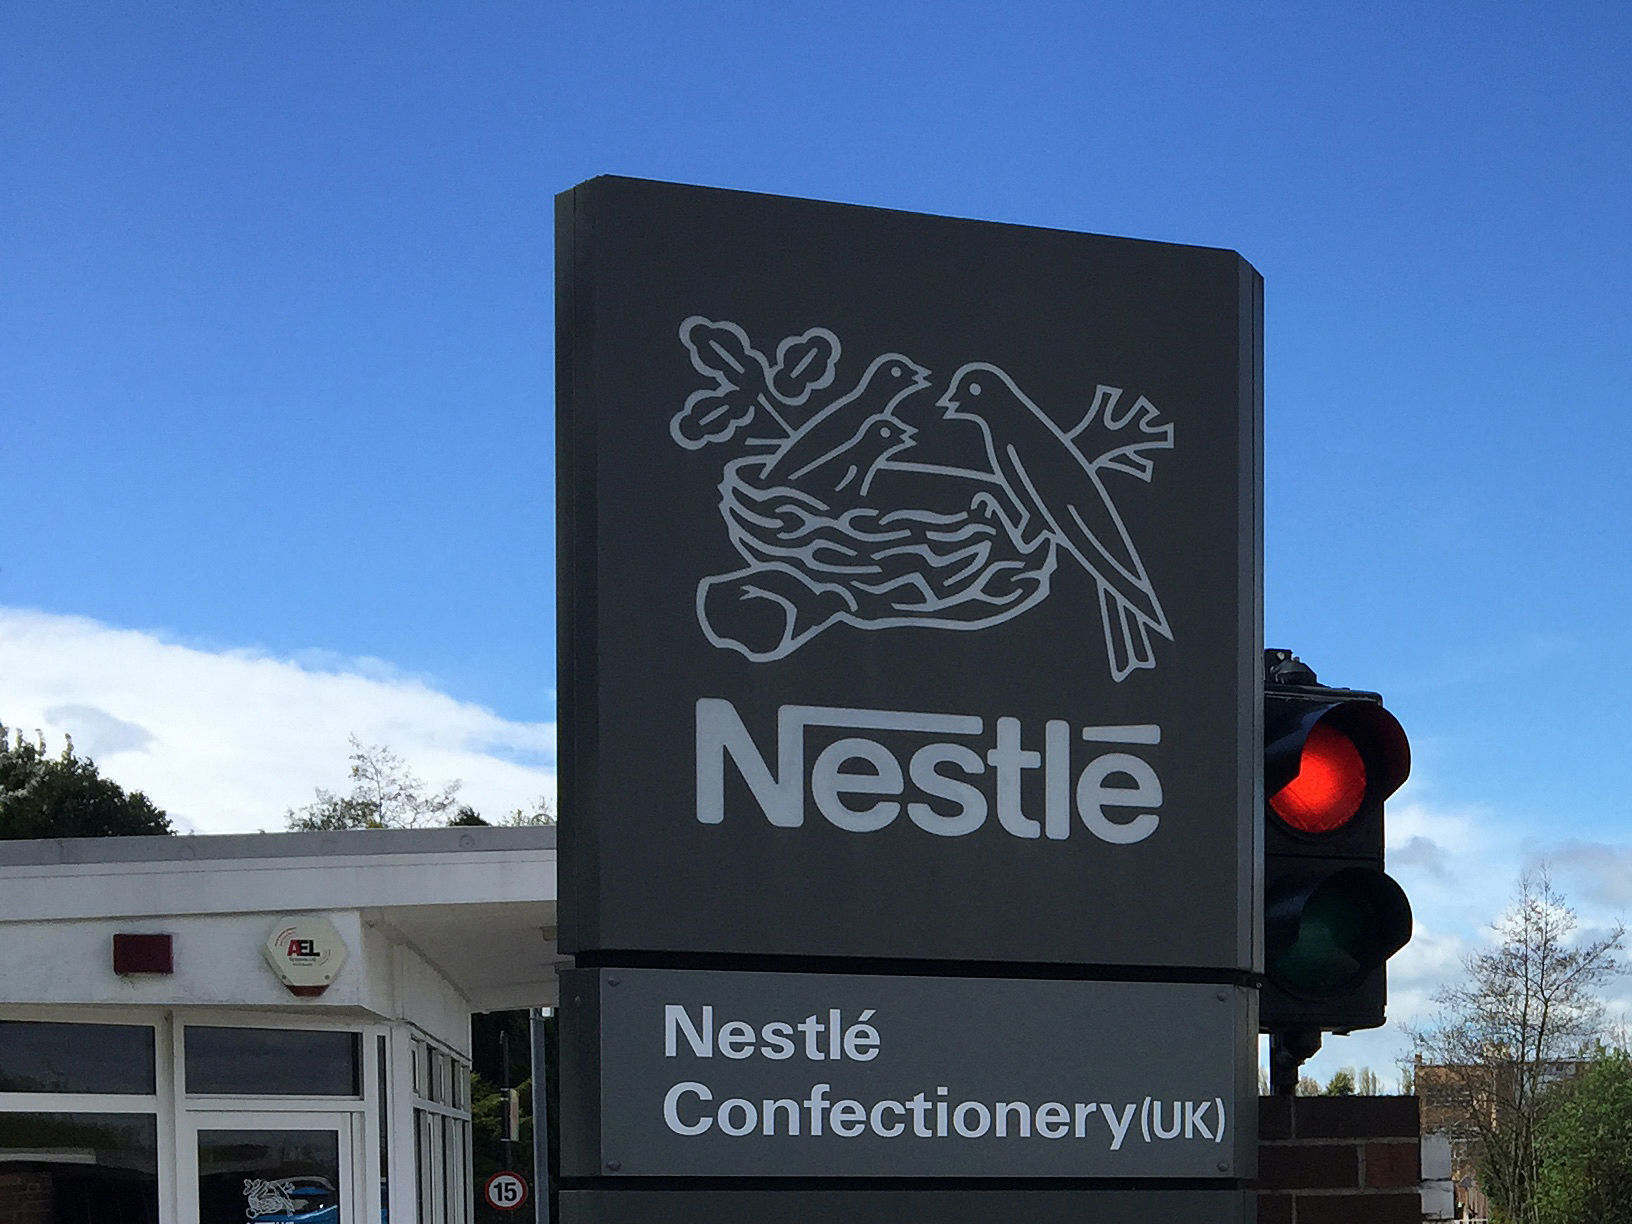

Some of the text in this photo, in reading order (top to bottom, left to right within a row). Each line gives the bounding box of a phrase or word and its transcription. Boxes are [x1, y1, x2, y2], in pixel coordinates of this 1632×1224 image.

[287, 939, 320, 956] AEL
[664, 1005, 881, 1062] Nestlé
[493, 1182, 517, 1202] 15
